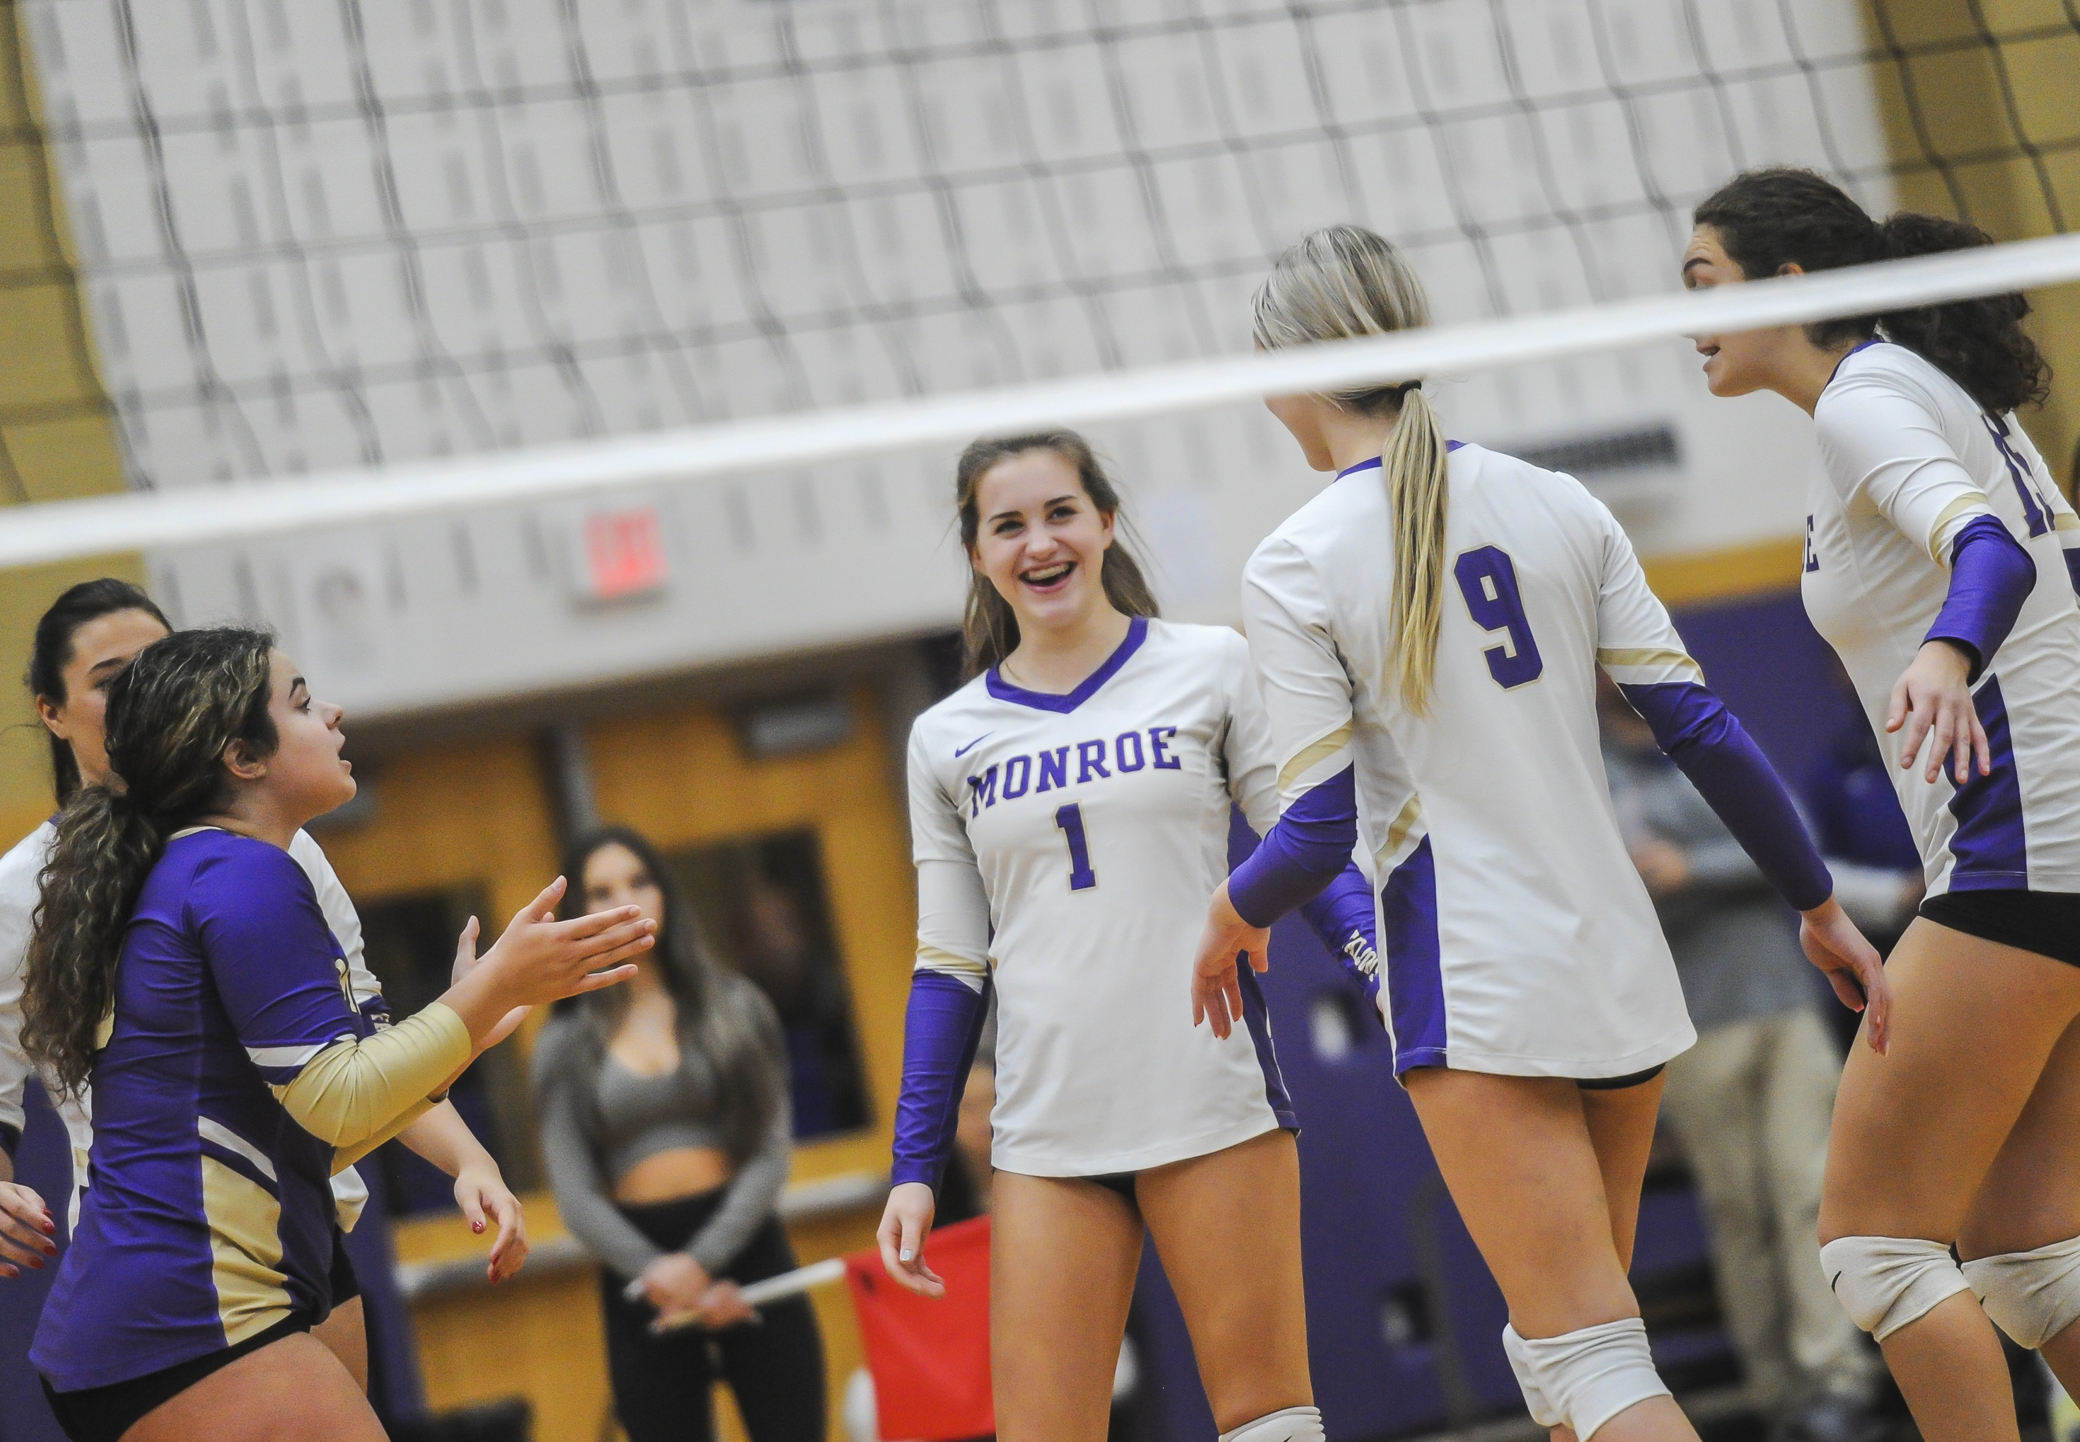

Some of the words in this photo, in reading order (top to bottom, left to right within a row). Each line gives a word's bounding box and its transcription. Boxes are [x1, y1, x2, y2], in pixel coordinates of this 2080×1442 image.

[1453, 543, 1544, 690] 9
[967, 725, 1182, 819] MONROE
[1055, 802, 1097, 891] 1
